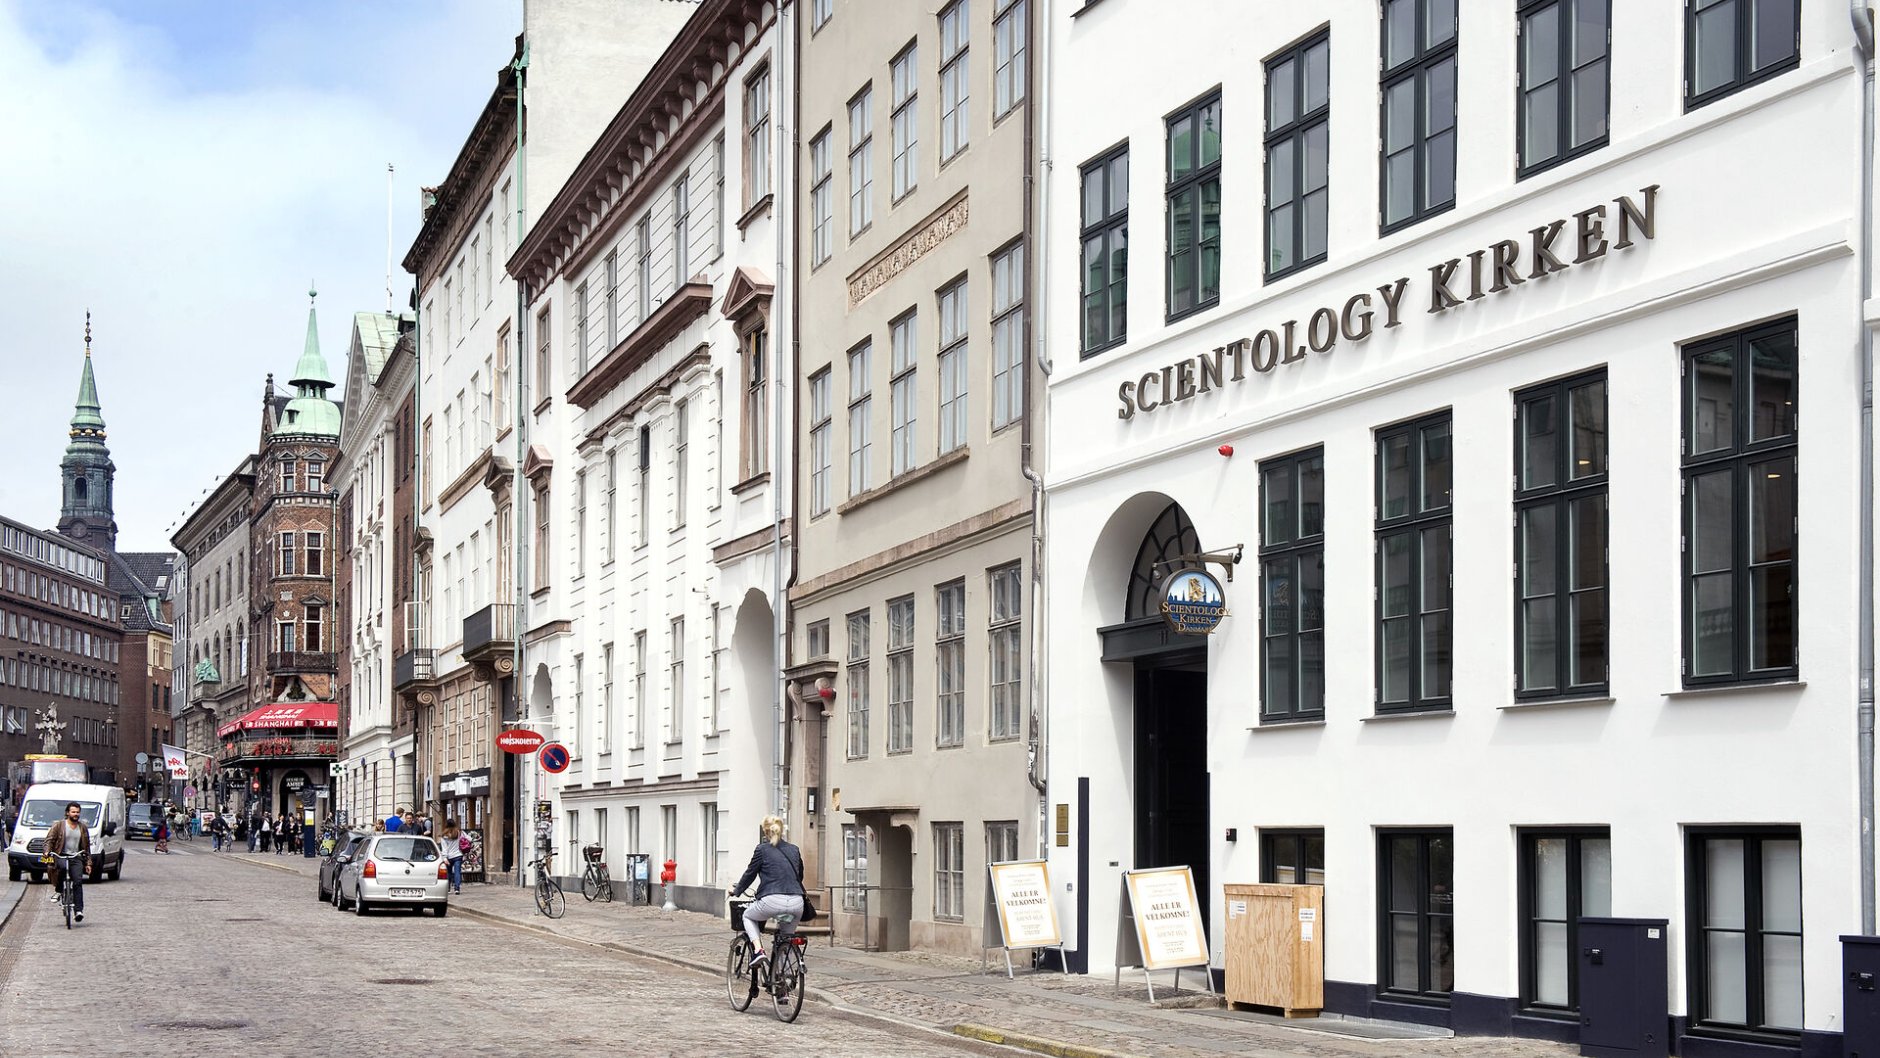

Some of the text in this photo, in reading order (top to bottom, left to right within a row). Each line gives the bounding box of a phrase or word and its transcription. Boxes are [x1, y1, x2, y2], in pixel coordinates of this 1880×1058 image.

[1118, 184, 1660, 420] SCIENTOLOGY KIRKEN
[1162, 602, 1231, 616] SCIENTOLOGY
[1179, 613, 1213, 624] KIRKEN
[254, 719, 293, 728] SHANGHAI
[1151, 901, 1182, 911] ALLE ER
[1145, 911, 1190, 921] VELKOMNE!
